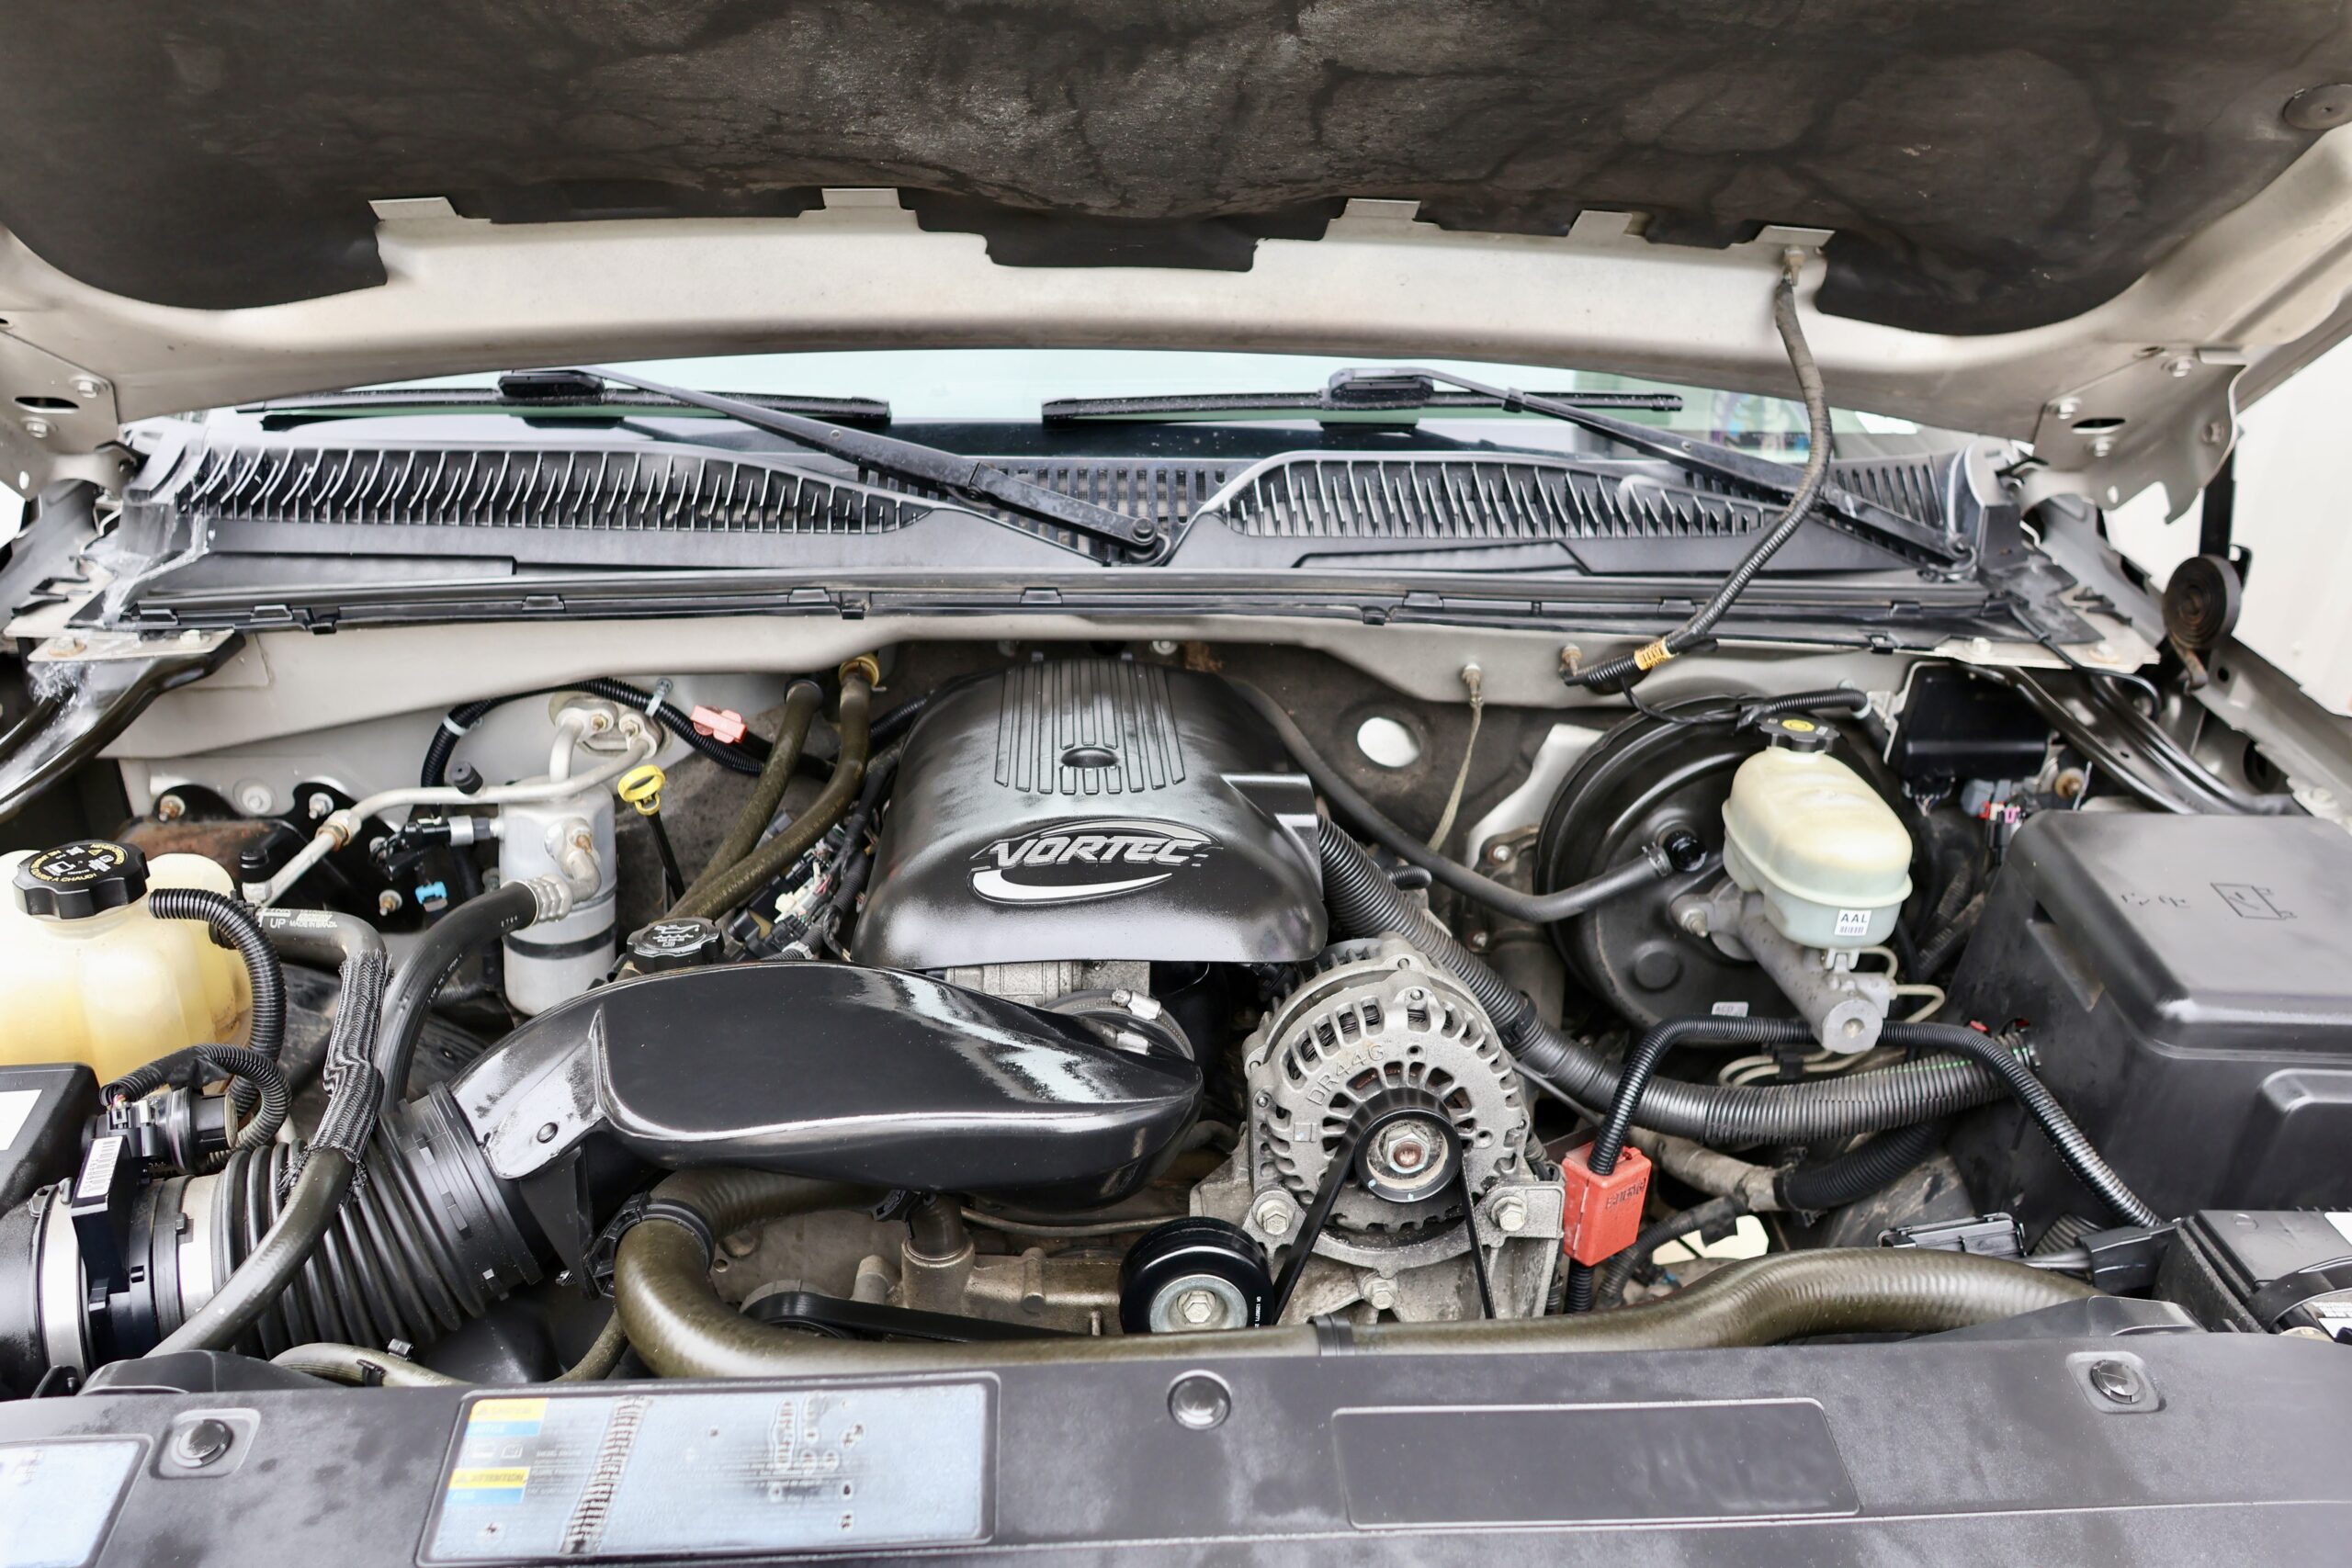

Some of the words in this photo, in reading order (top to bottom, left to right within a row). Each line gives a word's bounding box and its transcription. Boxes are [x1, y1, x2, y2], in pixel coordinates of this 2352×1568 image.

[988, 835, 1203, 868] VORTEC
[270, 918, 286, 929] UP
[1840, 913, 1868, 923] AAL
[1306, 1045, 1385, 1106] DR44G
